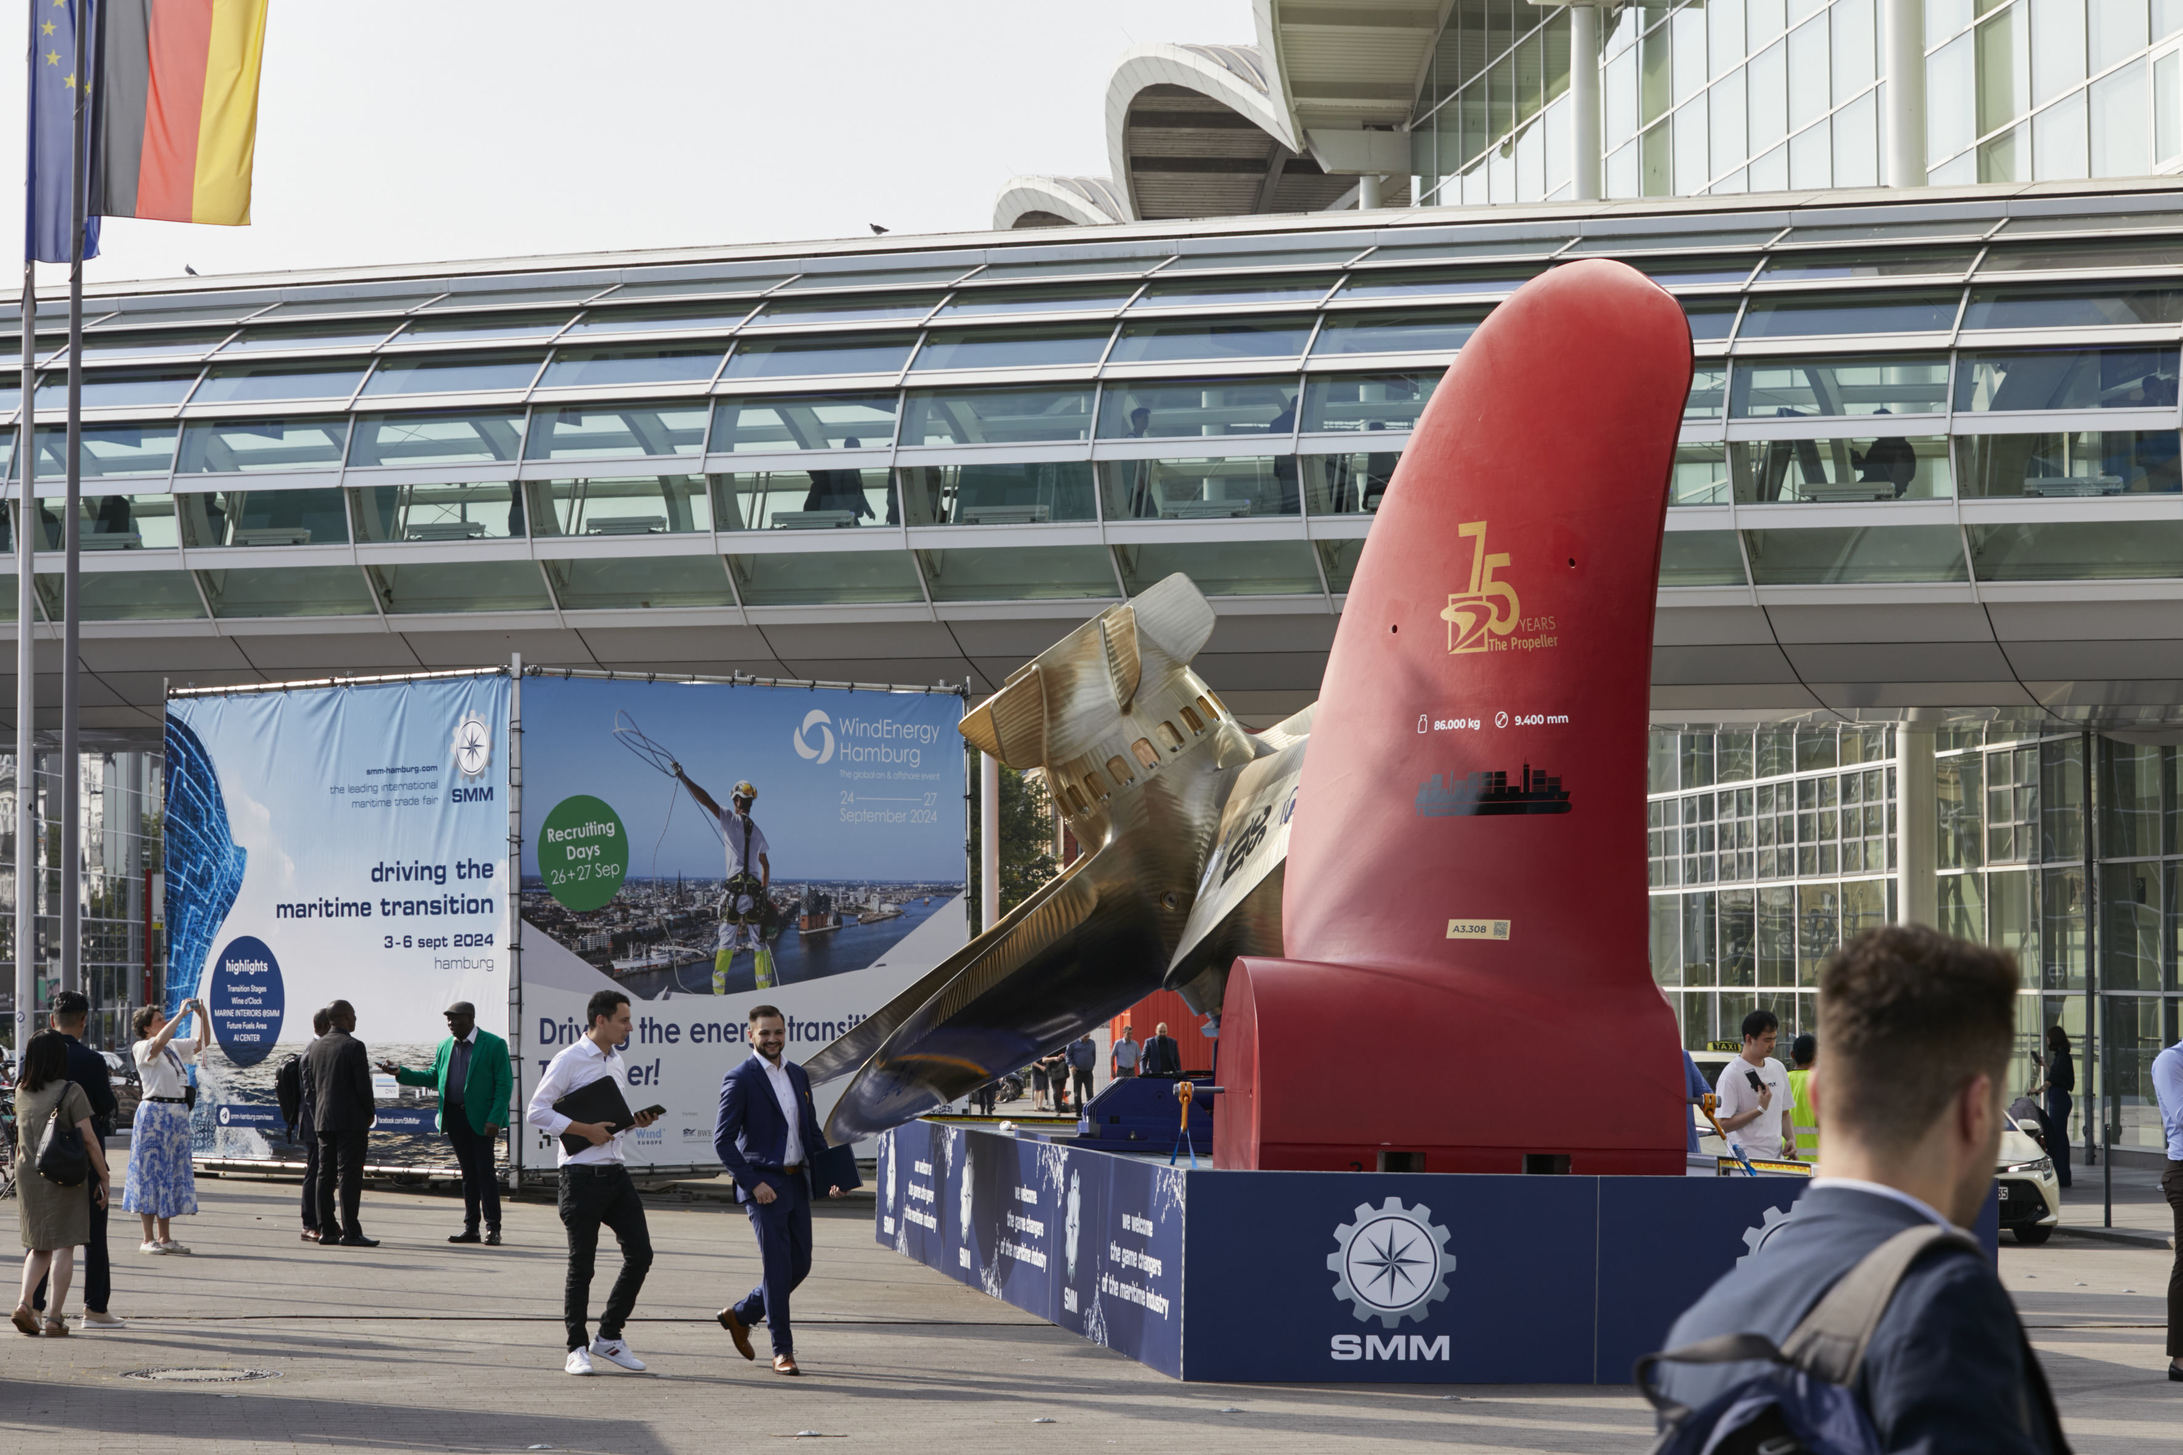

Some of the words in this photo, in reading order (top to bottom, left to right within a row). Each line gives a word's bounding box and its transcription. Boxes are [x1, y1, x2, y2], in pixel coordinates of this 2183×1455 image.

[1519, 616, 1556, 632] YEARS
[1488, 638, 1508, 652] The
[1511, 635, 1558, 652] Propeller
[1433, 719, 1466, 731] 86.000
[1468, 718, 1480, 730] kg
[1514, 714, 1544, 726] 9.400
[1547, 714, 1569, 725] mm
[839, 718, 940, 744] WindEnergy
[840, 743, 921, 768] Hamburg
[366, 765, 438, 776] smm-hamburg.com
[330, 784, 345, 794] the
[348, 782, 378, 795] leading
[381, 780, 438, 793] international
[452, 786, 494, 803] SMM
[352, 798, 392, 808] maritime
[394, 797, 420, 807] trade
[423, 796, 438, 805] fair
[840, 790, 854, 805] 24
[924, 792, 937, 806] 27
[840, 807, 907, 824] September
[910, 809, 937, 823] 2024
[547, 820, 615, 843] Recruiting
[566, 844, 600, 861] Days
[371, 860, 447, 885] driving
[456, 858, 494, 880] the
[595, 862, 620, 879] Sep
[276, 897, 372, 918] maritime
[380, 893, 494, 916] transition
[1452, 925, 1487, 933] A3.308
[418, 935, 448, 950] sept
[453, 933, 494, 948] 2024
[225, 959, 269, 975] highlights
[435, 957, 494, 972] hamburg
[227, 984, 250, 992] Transition
[250, 984, 267, 994] Stages
[214, 1009, 234, 1017] MARINE
[235, 1009, 262, 1017] INTERIORS
[226, 1021, 242, 1029] Future
[639, 1017, 681, 1044] the
[690, 1022, 755, 1048] ener
[240, 1034, 260, 1042] CENTER
[1715, 1042, 1737, 1051] TAXI
[636, 1128, 662, 1139] Wind
[1122, 1213, 1130, 1231] we
[1131, 1212, 1154, 1237] welcome
[959, 1246, 971, 1269] SMM
[1110, 1239, 1121, 1262] the
[1121, 1247, 1138, 1269] game
[1138, 1248, 1162, 1279] changers
[1064, 1286, 1078, 1314] SMM
[1101, 1271, 1109, 1293] of
[1109, 1274, 1119, 1297] the
[1119, 1280, 1146, 1306] maritime
[1146, 1285, 1170, 1320] industry
[1330, 1334, 1451, 1361] SMM
